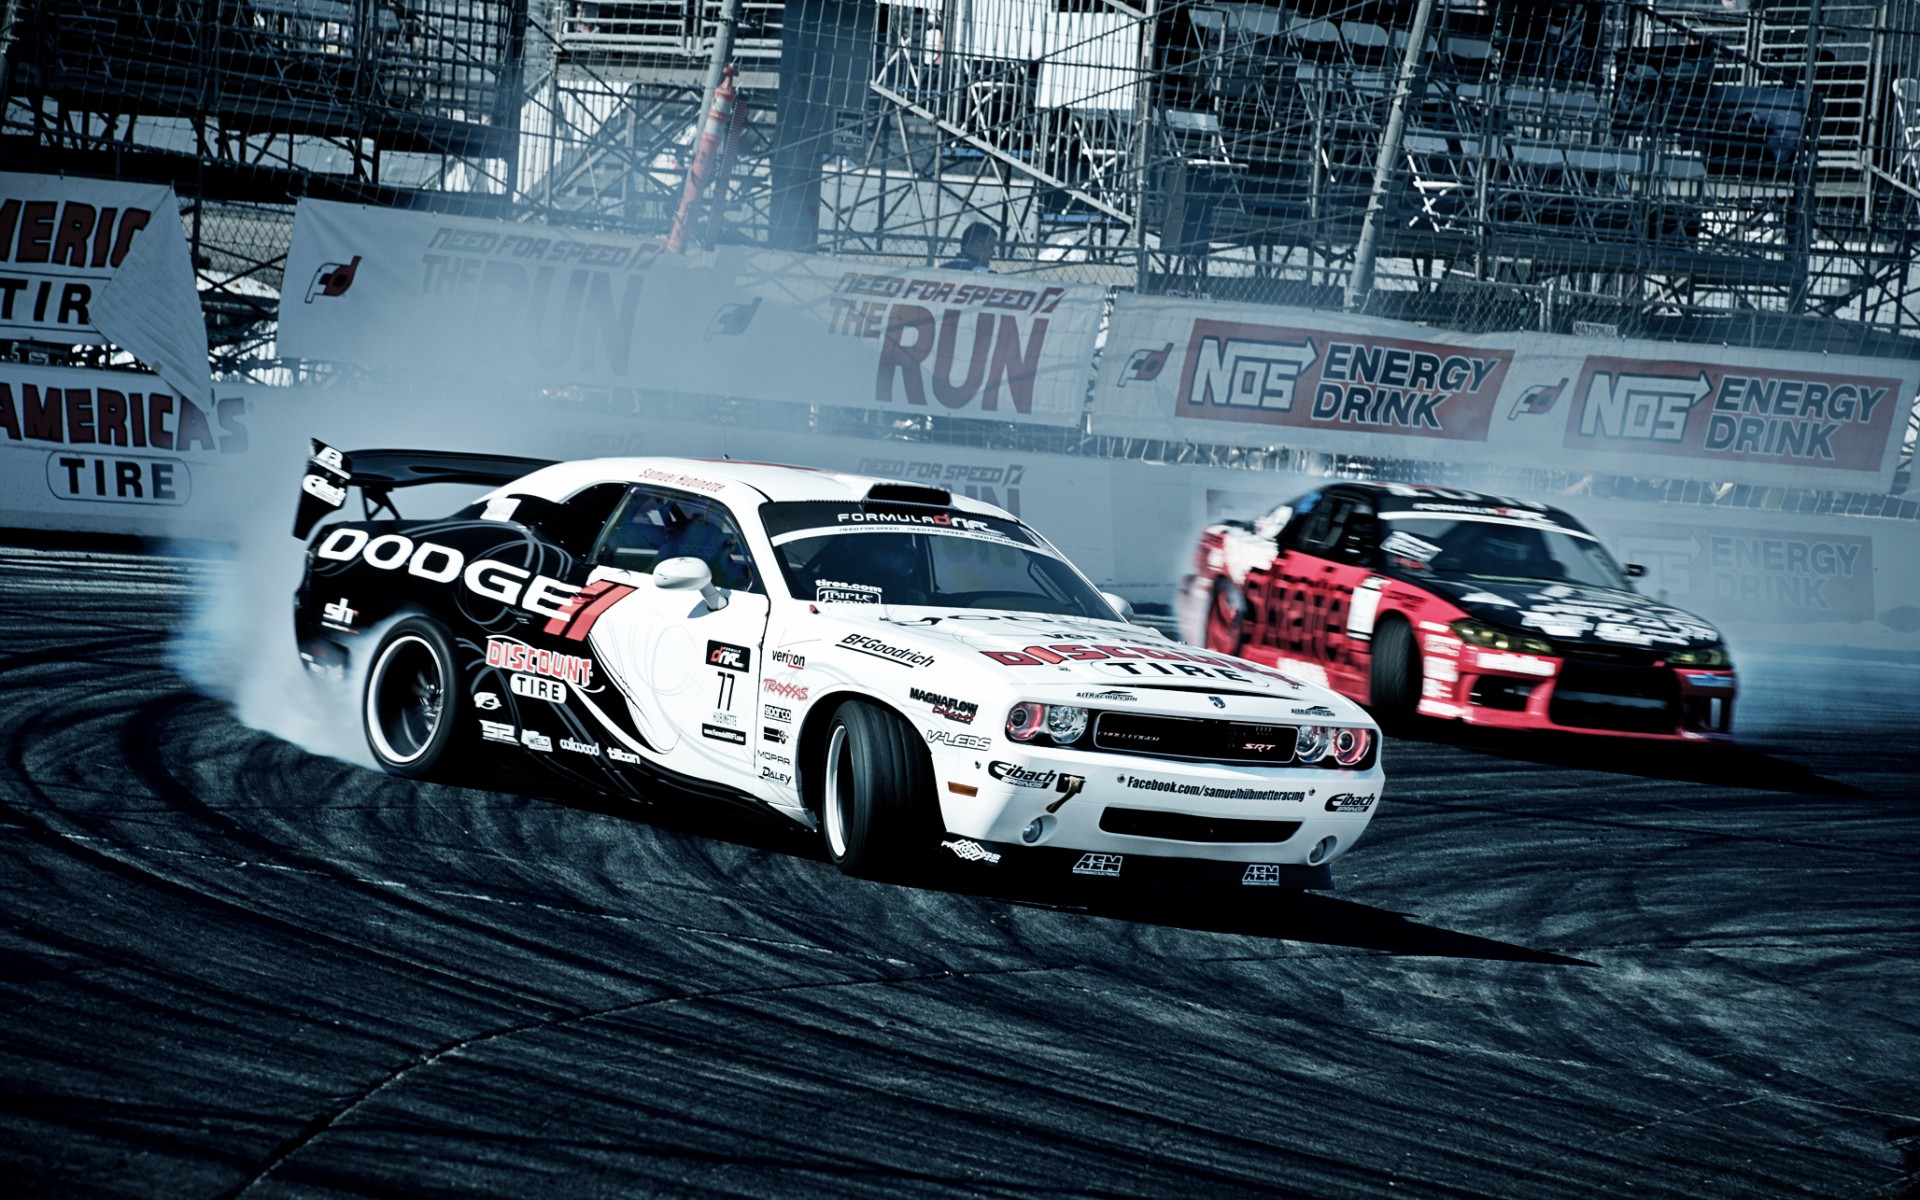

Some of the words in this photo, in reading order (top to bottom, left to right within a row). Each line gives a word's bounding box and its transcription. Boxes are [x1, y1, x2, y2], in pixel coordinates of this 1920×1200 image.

[428, 227, 499, 253] NEED
[495, 235, 550, 260] FOR
[547, 241, 631, 267] SPEED
[422, 254, 482, 298] THE
[835, 272, 904, 297] NEED
[904, 280, 955, 301] FOR
[953, 284, 1036, 311] SPEED
[828, 298, 888, 339] THE
[875, 304, 1049, 414] RUN
[1188, 335, 1319, 412] NOS
[1321, 342, 1501, 394] ENERGY
[1310, 384, 1451, 430] DRINK
[1578, 370, 1713, 443] NOS
[1714, 374, 1889, 424] ENERGY
[1703, 414, 1844, 461] DRINK
[60, 457, 175, 499] TIRE
[857, 457, 905, 477] NEED
[905, 461, 943, 480] FOR
[943, 464, 1004, 483] SPEED
[1710, 534, 1862, 576] ENERGY
[318, 528, 583, 622] DODGE
[815, 579, 883, 593] tires.com
[1712, 571, 1832, 611] DRINK
[487, 640, 592, 687] DISCOUNT
[772, 650, 806, 670] verizon
[841, 633, 935, 668] BFGoodrich
[516, 676, 560, 701] TIRE
[1105, 662, 1252, 684] TIRE
[717, 671, 736, 711] 77
[763, 679, 809, 701] TRAXXAS
[909, 687, 979, 714] MAGNAFLOW
[765, 705, 791, 721] sparco
[926, 729, 991, 752] V-LEDS
[1242, 742, 1276, 753] SRT
[757, 749, 791, 766] MOPAR
[988, 760, 1057, 782] Eibach
[1324, 792, 1375, 812] Eibach
[1073, 852, 1123, 872] AEM
[1242, 864, 1279, 882] AEM
